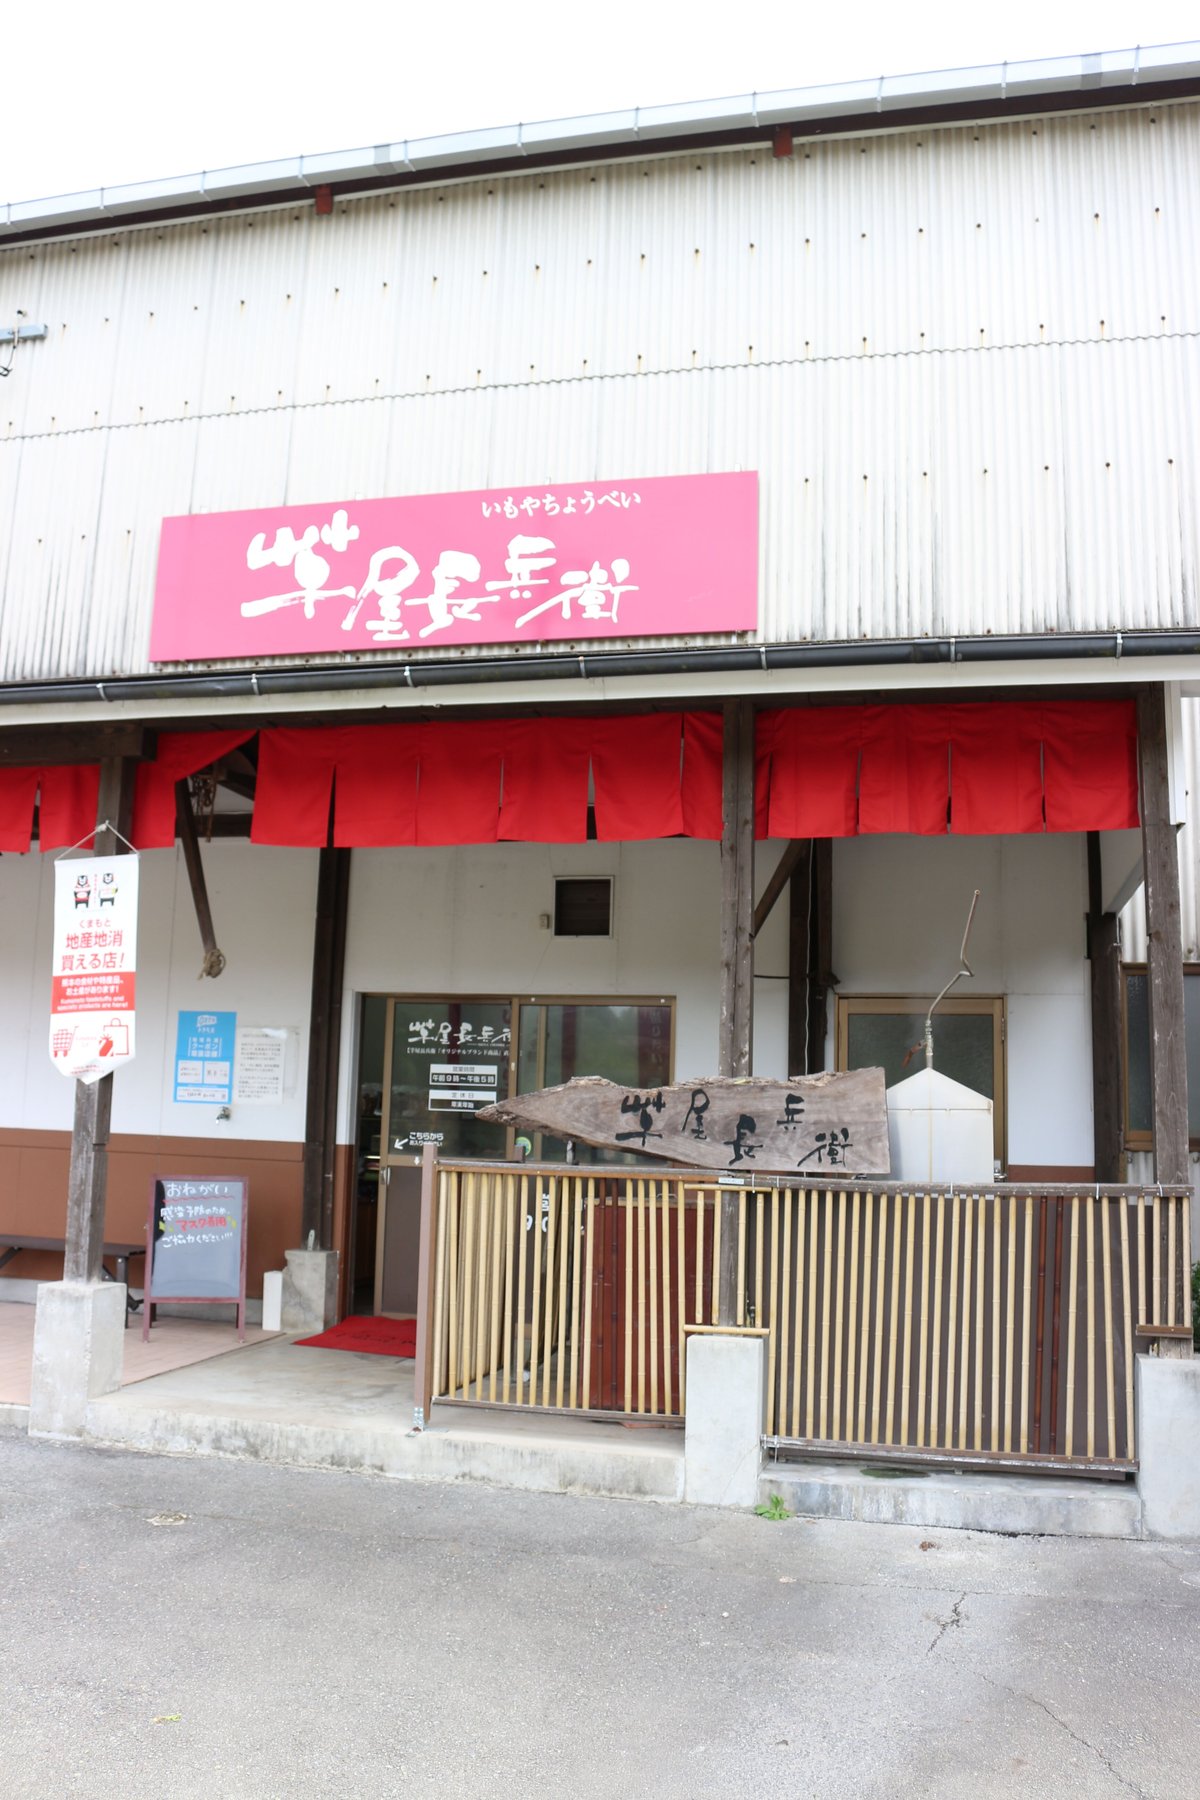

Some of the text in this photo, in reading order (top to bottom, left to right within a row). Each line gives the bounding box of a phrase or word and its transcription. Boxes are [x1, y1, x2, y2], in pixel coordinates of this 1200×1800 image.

[482, 490, 641, 519] いもやちょうべい
[79, 918, 112, 928] くまもと
[66, 930, 123, 949] 地産地消
[409, 1132, 444, 1141] こちらから
[167, 1182, 229, 1197] おねがい
